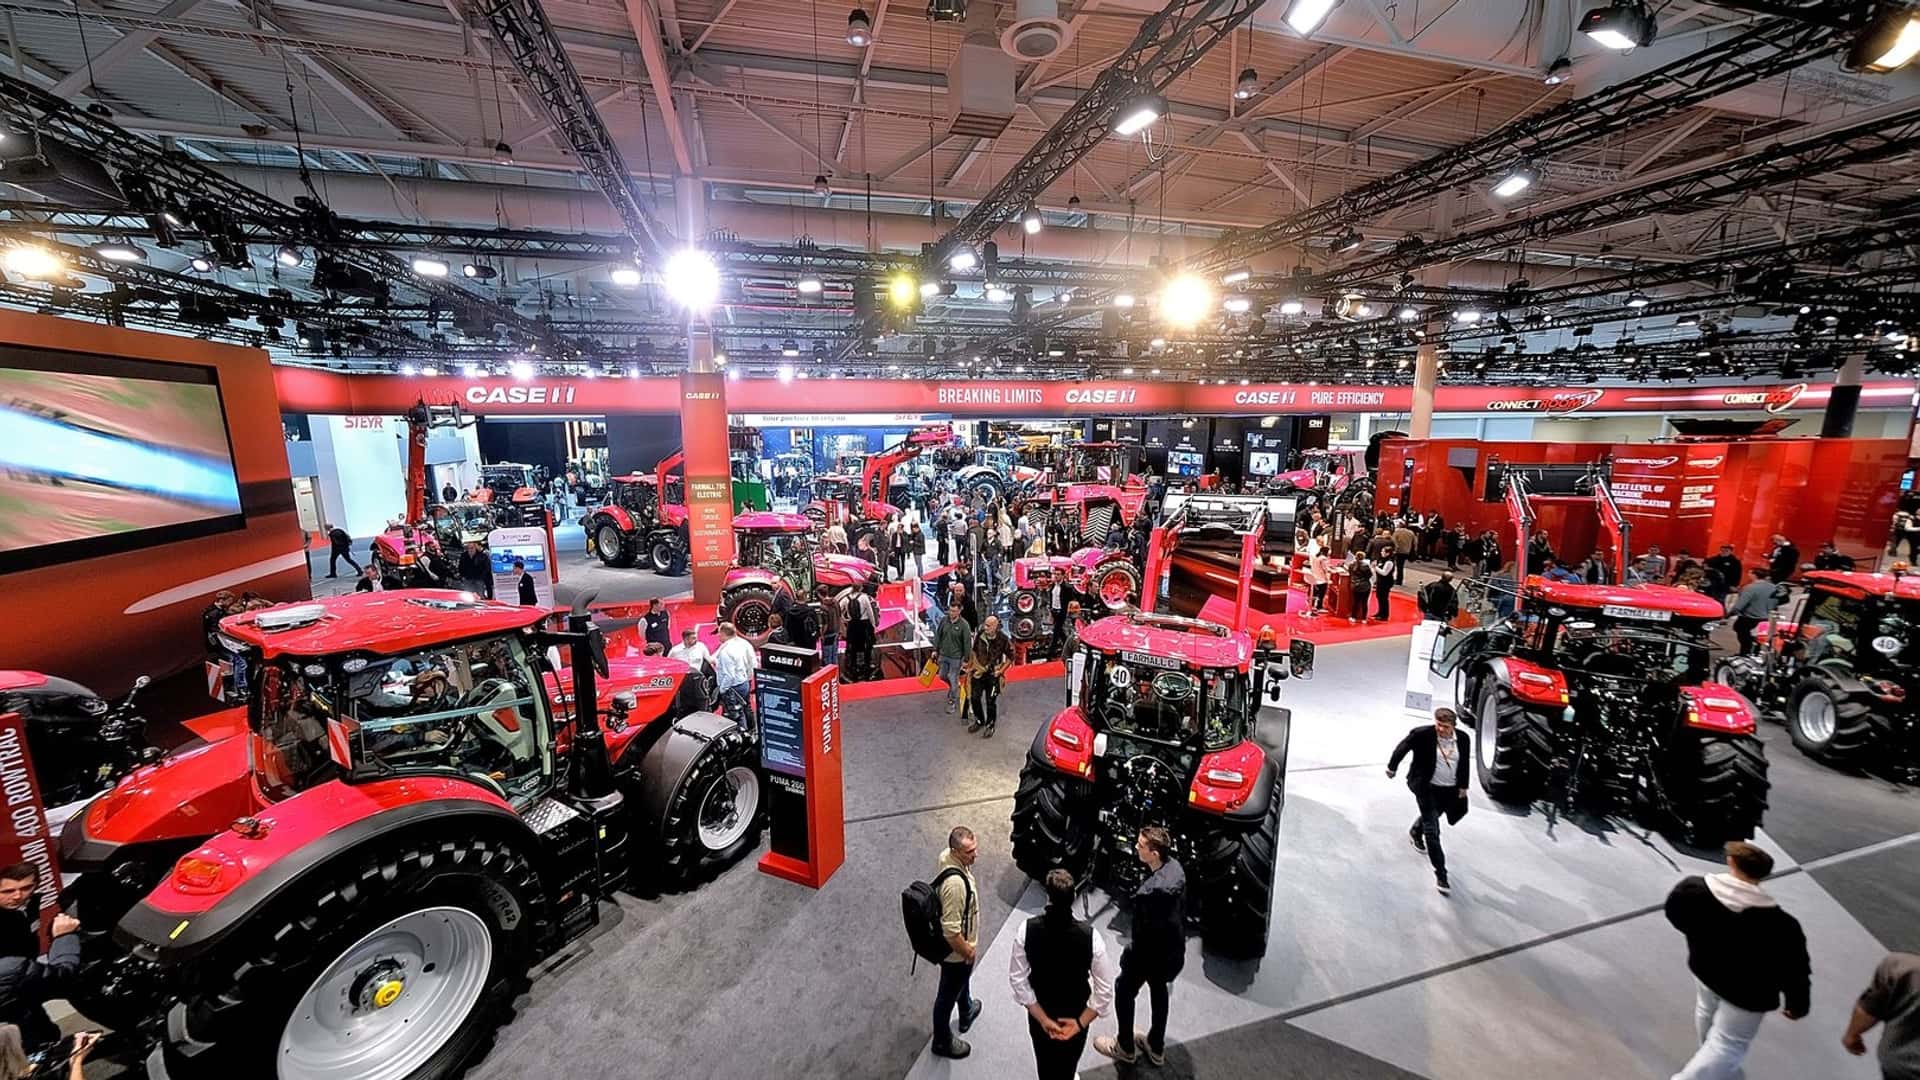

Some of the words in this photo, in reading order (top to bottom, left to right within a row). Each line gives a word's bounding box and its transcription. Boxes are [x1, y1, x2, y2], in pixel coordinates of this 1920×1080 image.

[466, 386, 547, 404] CASE
[685, 392, 710, 400] CASE
[938, 388, 1001, 404] BREAKING
[1005, 388, 1043, 404] LIMITS
[1065, 389, 1119, 404] CASE
[1235, 391, 1281, 404] CASE
[1311, 391, 1334, 404] PURE
[1337, 391, 1385, 405] EFFICIENCY
[344, 415, 384, 429] STEYR
[1630, 483, 1652, 492] LEVEL
[768, 655, 794, 666] CASE
[1127, 653, 1167, 667] FARMALL
[1167, 659, 1174, 668] C
[651, 677, 673, 687] 260
[1112, 668, 1127, 684] 40
[820, 681, 831, 712] 260
[822, 712, 832, 755] PUMA
[0, 727, 34, 807] ROWTRAC
[769, 774, 790, 786] PUMA
[11, 804, 41, 837] 400
